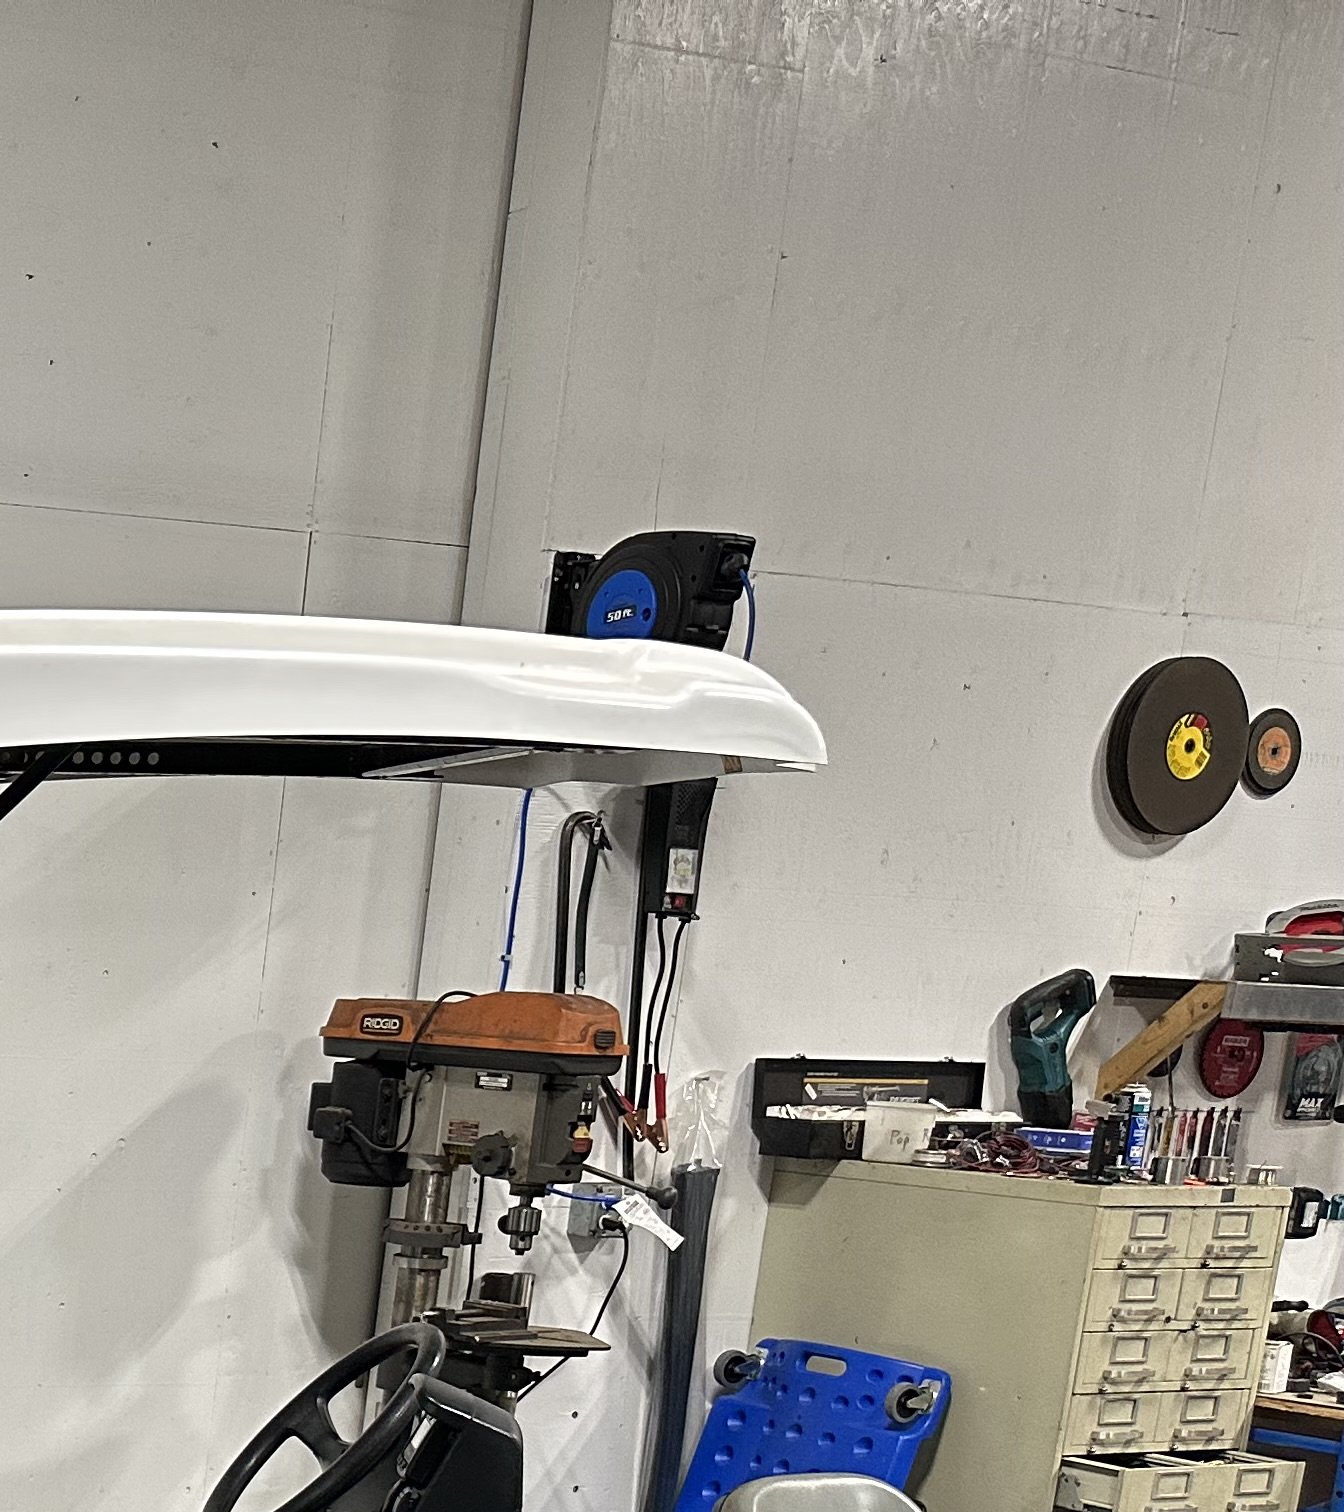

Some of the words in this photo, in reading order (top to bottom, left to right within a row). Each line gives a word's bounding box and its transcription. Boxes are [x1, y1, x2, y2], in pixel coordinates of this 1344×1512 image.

[605, 609, 622, 623] 50
[362, 1017, 400, 1030] RIDGID
[889, 1129, 910, 1151] Pop
